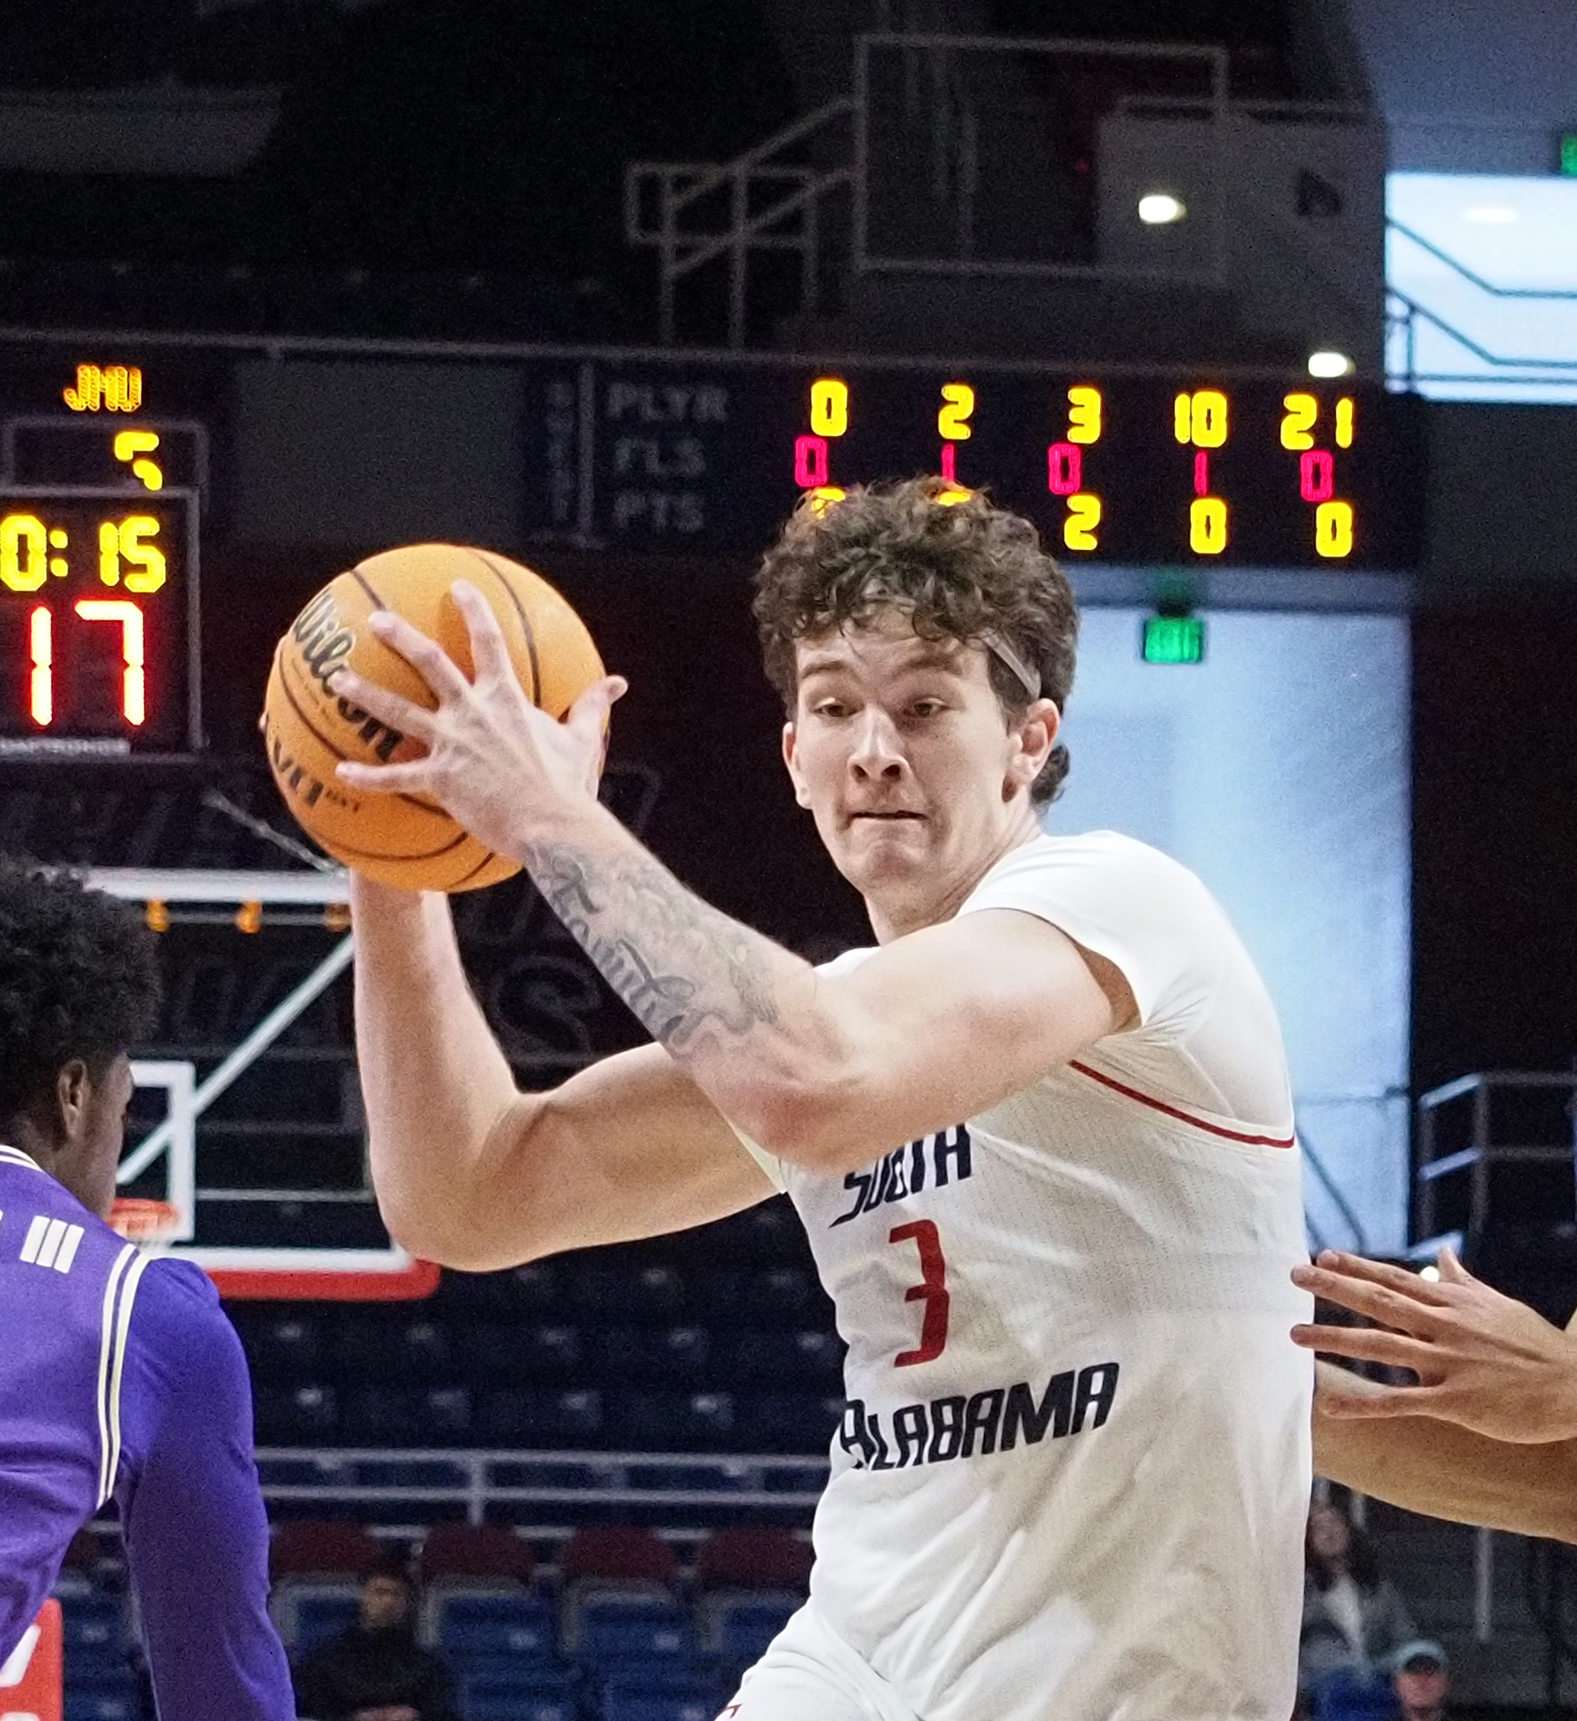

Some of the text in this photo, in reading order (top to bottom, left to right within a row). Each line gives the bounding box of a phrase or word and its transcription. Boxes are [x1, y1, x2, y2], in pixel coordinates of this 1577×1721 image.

[63, 364, 142, 412] JMU
[810, 380, 1353, 450] 0 2 3 10 21
[795, 435, 827, 488] 0
[1050, 443, 1082, 495] 0
[1194, 451, 1208, 497] 1
[1302, 450, 1333, 503] 0
[1064, 495, 1353, 558] 2 0 0
[29, 600, 146, 727] 17
[19, 1215, 85, 1274] III
[888, 1217, 951, 1369] 3
[838, 1361, 1121, 1473] ALABAMA
